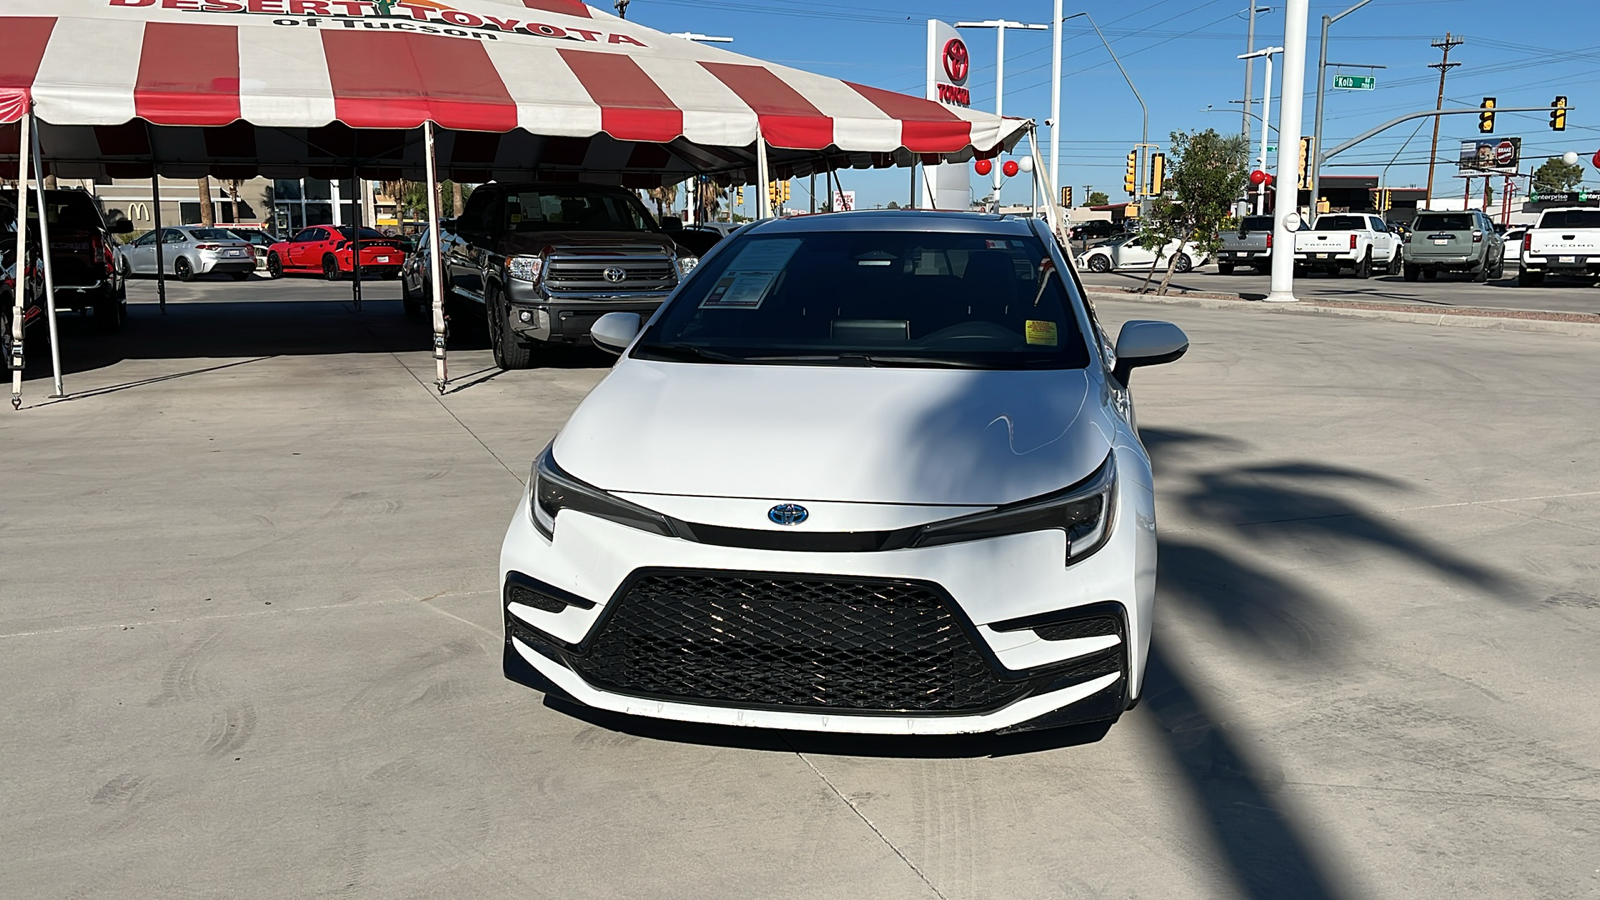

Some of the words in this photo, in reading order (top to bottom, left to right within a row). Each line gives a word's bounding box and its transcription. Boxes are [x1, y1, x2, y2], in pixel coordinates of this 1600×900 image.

[273, 18, 322, 27] of
[331, 18, 498, 41] Tucson
[396, 2, 649, 48] TOYOTA
[1338, 77, 1354, 87] Kolb
[936, 83, 971, 106] TOYOTA
[1533, 193, 1568, 202] enterprise
